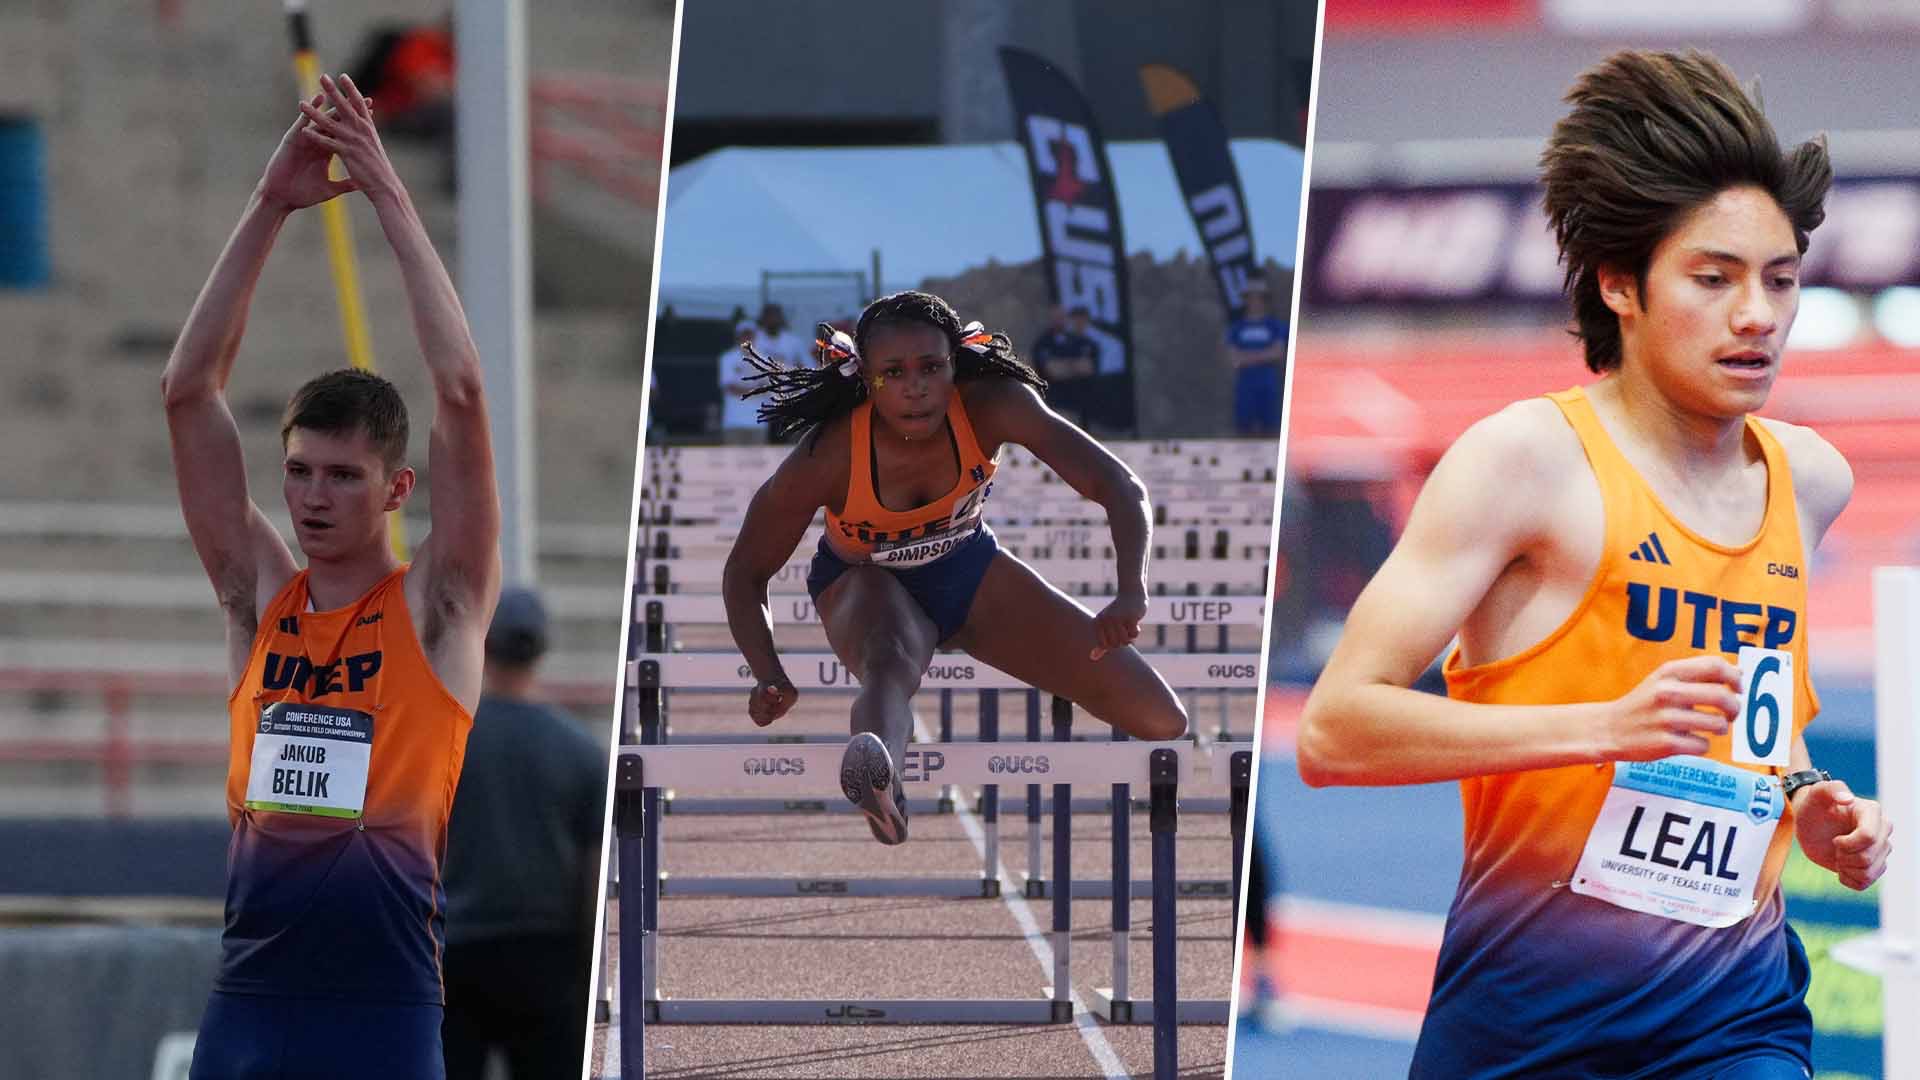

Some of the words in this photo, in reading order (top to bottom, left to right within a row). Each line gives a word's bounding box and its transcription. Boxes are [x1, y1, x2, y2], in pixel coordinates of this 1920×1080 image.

[1171, 602, 1232, 621] UTEP
[1626, 582, 1797, 654] UTEP
[818, 661, 851, 685] UT
[942, 666, 975, 680] UCS
[1221, 665, 1255, 679] UCS
[1746, 656, 1780, 758] 6
[286, 712, 334, 725] CONFERENCE
[335, 716, 352, 728] USA
[280, 743, 326, 765] JAKUB
[1004, 756, 1051, 774] UCS
[761, 758, 805, 776] UCS
[902, 751, 945, 783] EP
[1656, 762, 1720, 786] CONFERENCE
[1721, 775, 1737, 790] USA
[272, 767, 330, 799] BELIK
[1619, 805, 1740, 881] LEAL
[1601, 857, 1654, 880] UNIVERSITY
[1656, 872, 1669, 884] OF
[1671, 877, 1700, 892] TEXAS
[1700, 882, 1712, 893] AT
[1713, 884, 1723, 896] EL
